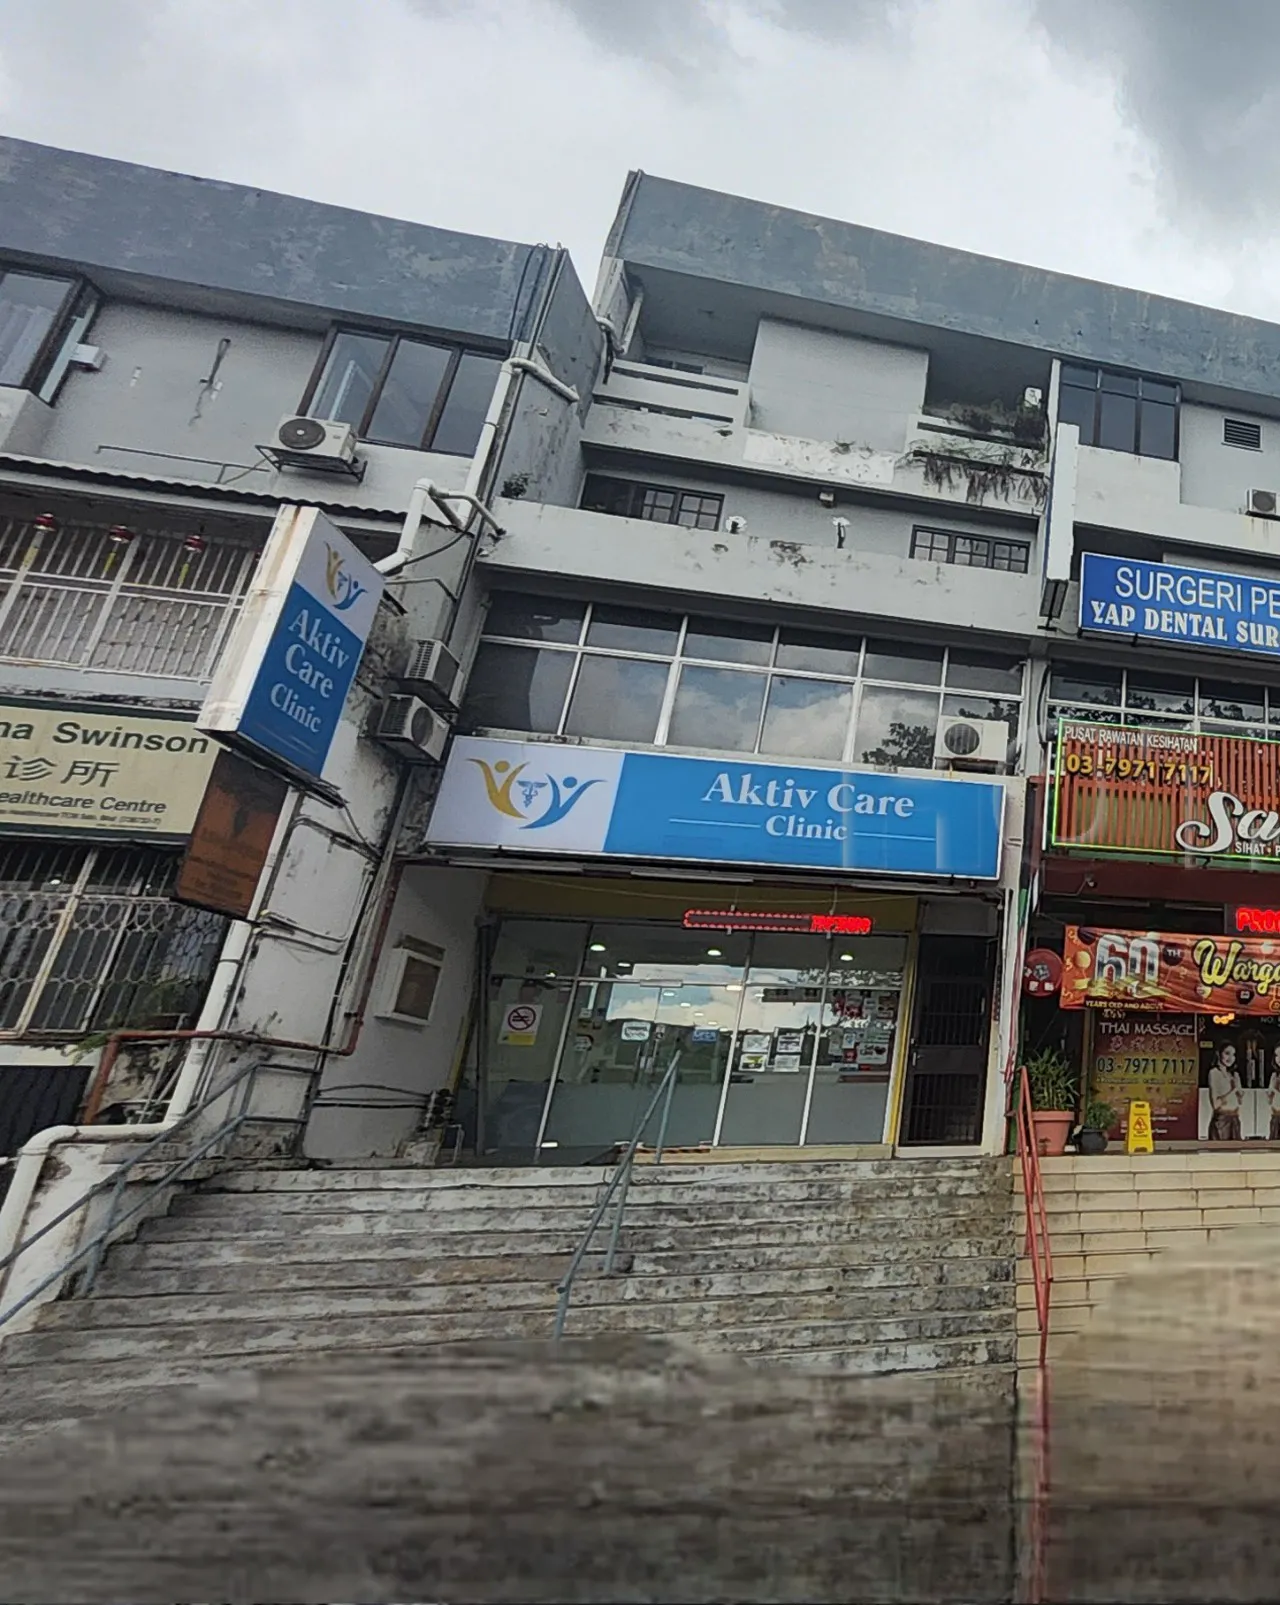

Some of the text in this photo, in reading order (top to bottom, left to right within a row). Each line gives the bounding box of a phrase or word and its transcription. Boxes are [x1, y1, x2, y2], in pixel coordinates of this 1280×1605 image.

[1116, 566, 1241, 613] SURGERI
[1090, 601, 1135, 627] YAP
[1144, 607, 1228, 641] DENTAL
[288, 609, 349, 669] Aktiv
[285, 643, 333, 698] Care
[270, 683, 321, 733] Clinic
[52, 721, 209, 754] Swinson
[1064, 725, 1198, 752] PUSAT RAWATAN KESIHATAN
[1164, 763, 1212, 784] 7117
[100, 796, 166, 814] Centre
[701, 772, 914, 817] Aktiv Care
[765, 814, 848, 840] Clinic
[1234, 841, 1267, 855] SIHAT
[1100, 1022, 1195, 1036] THAI MASSAGE
[1162, 1058, 1195, 1075] 7117
